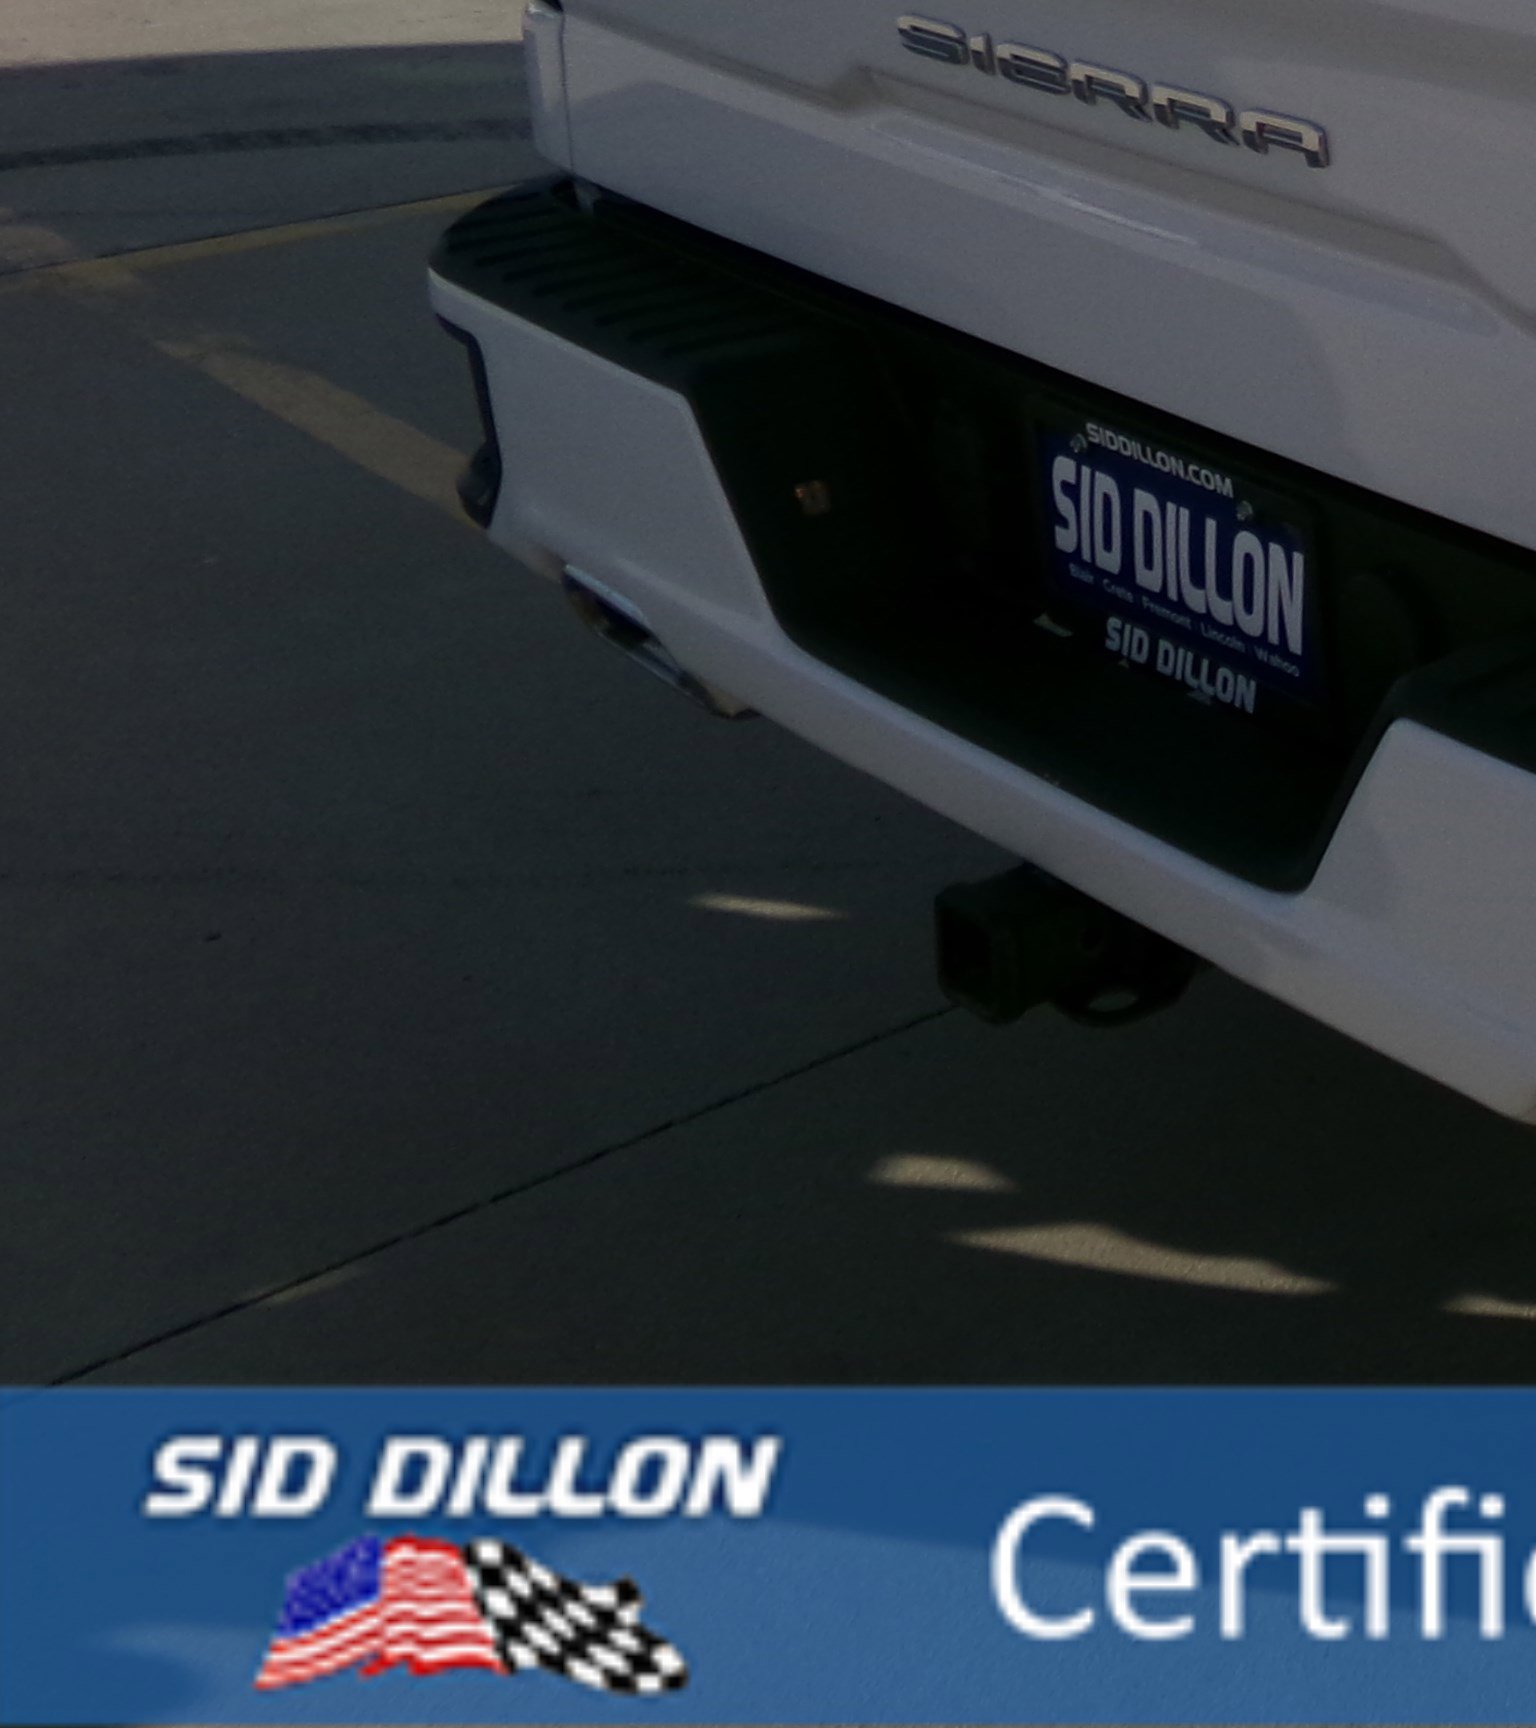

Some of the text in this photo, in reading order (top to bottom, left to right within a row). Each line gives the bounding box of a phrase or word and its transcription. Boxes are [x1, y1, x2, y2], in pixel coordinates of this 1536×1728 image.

[896, 12, 1332, 169] SIERRA
[1086, 422, 1234, 498] SIDDILLON.COM
[1052, 455, 1305, 656] SID DILLON
[1104, 616, 1257, 714] SID DILLON
[1142, 595, 1192, 630] Fremont
[1200, 622, 1246, 653] Lincoln
